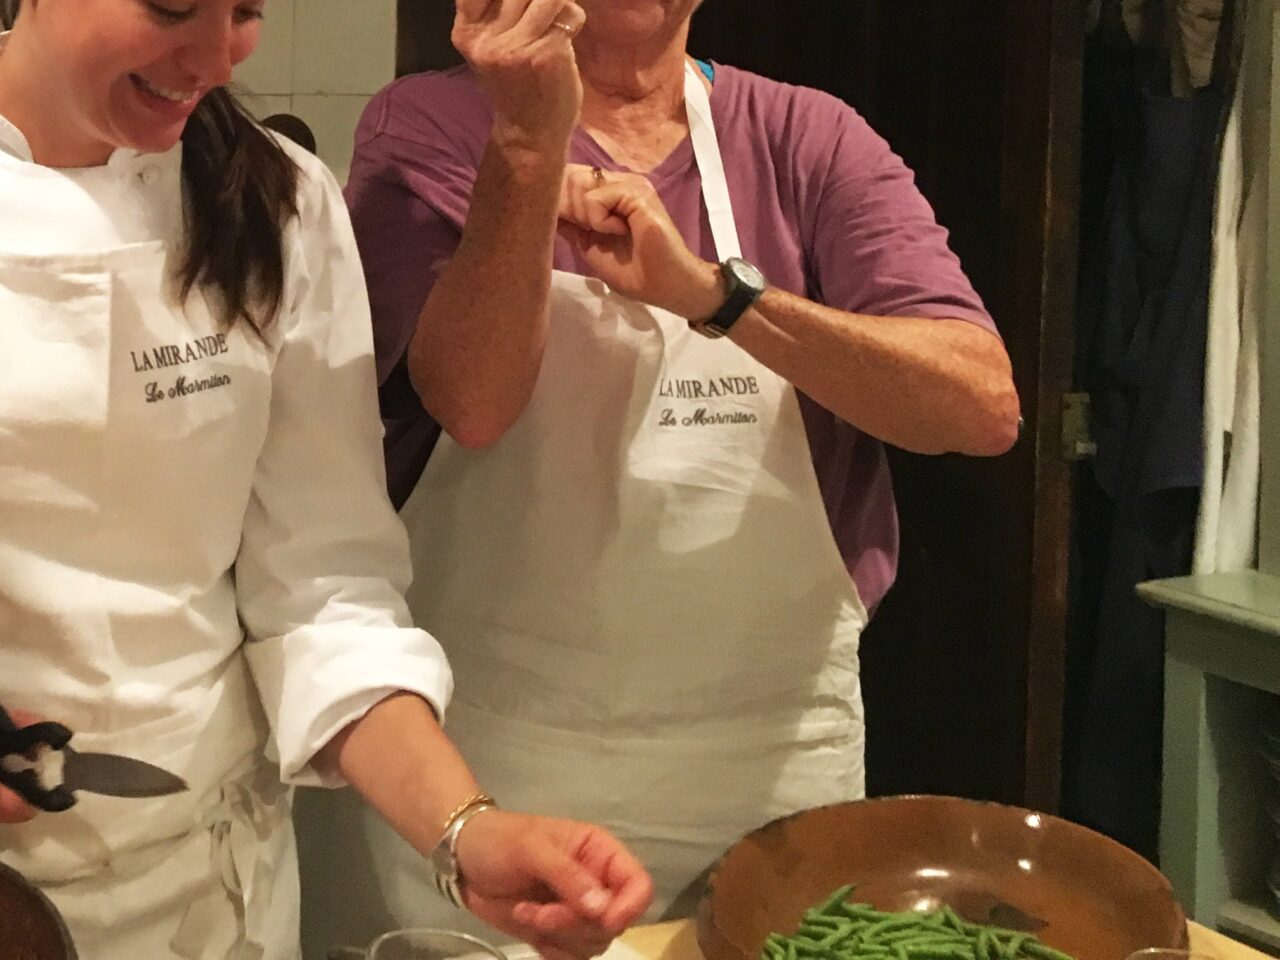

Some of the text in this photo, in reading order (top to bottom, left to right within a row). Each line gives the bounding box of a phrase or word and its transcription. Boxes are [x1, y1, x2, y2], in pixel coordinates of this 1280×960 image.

[130, 333, 229, 372] LA MIRANDE
[145, 381, 165, 403] Le
[658, 375, 760, 399] LA MIRANDE
